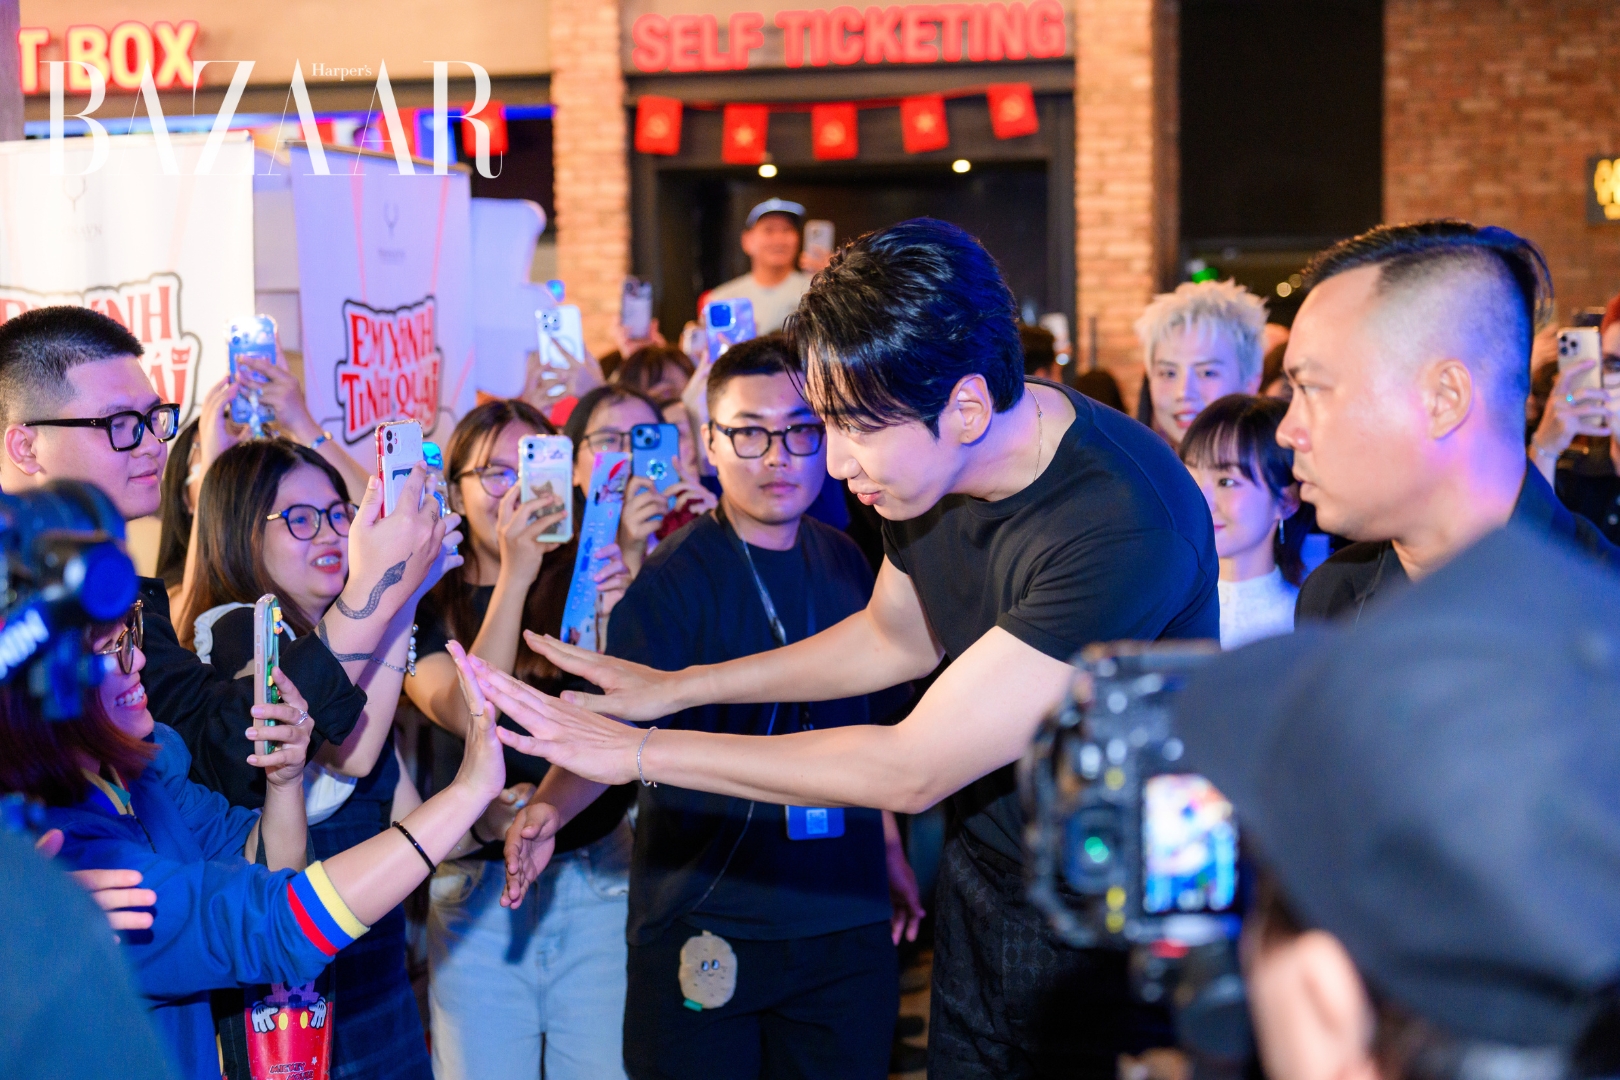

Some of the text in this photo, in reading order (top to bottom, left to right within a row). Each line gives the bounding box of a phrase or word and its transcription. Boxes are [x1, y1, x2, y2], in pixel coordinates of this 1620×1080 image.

[65, 20, 203, 93] BOX
[632, 0, 1066, 73] SELF TICKETING
